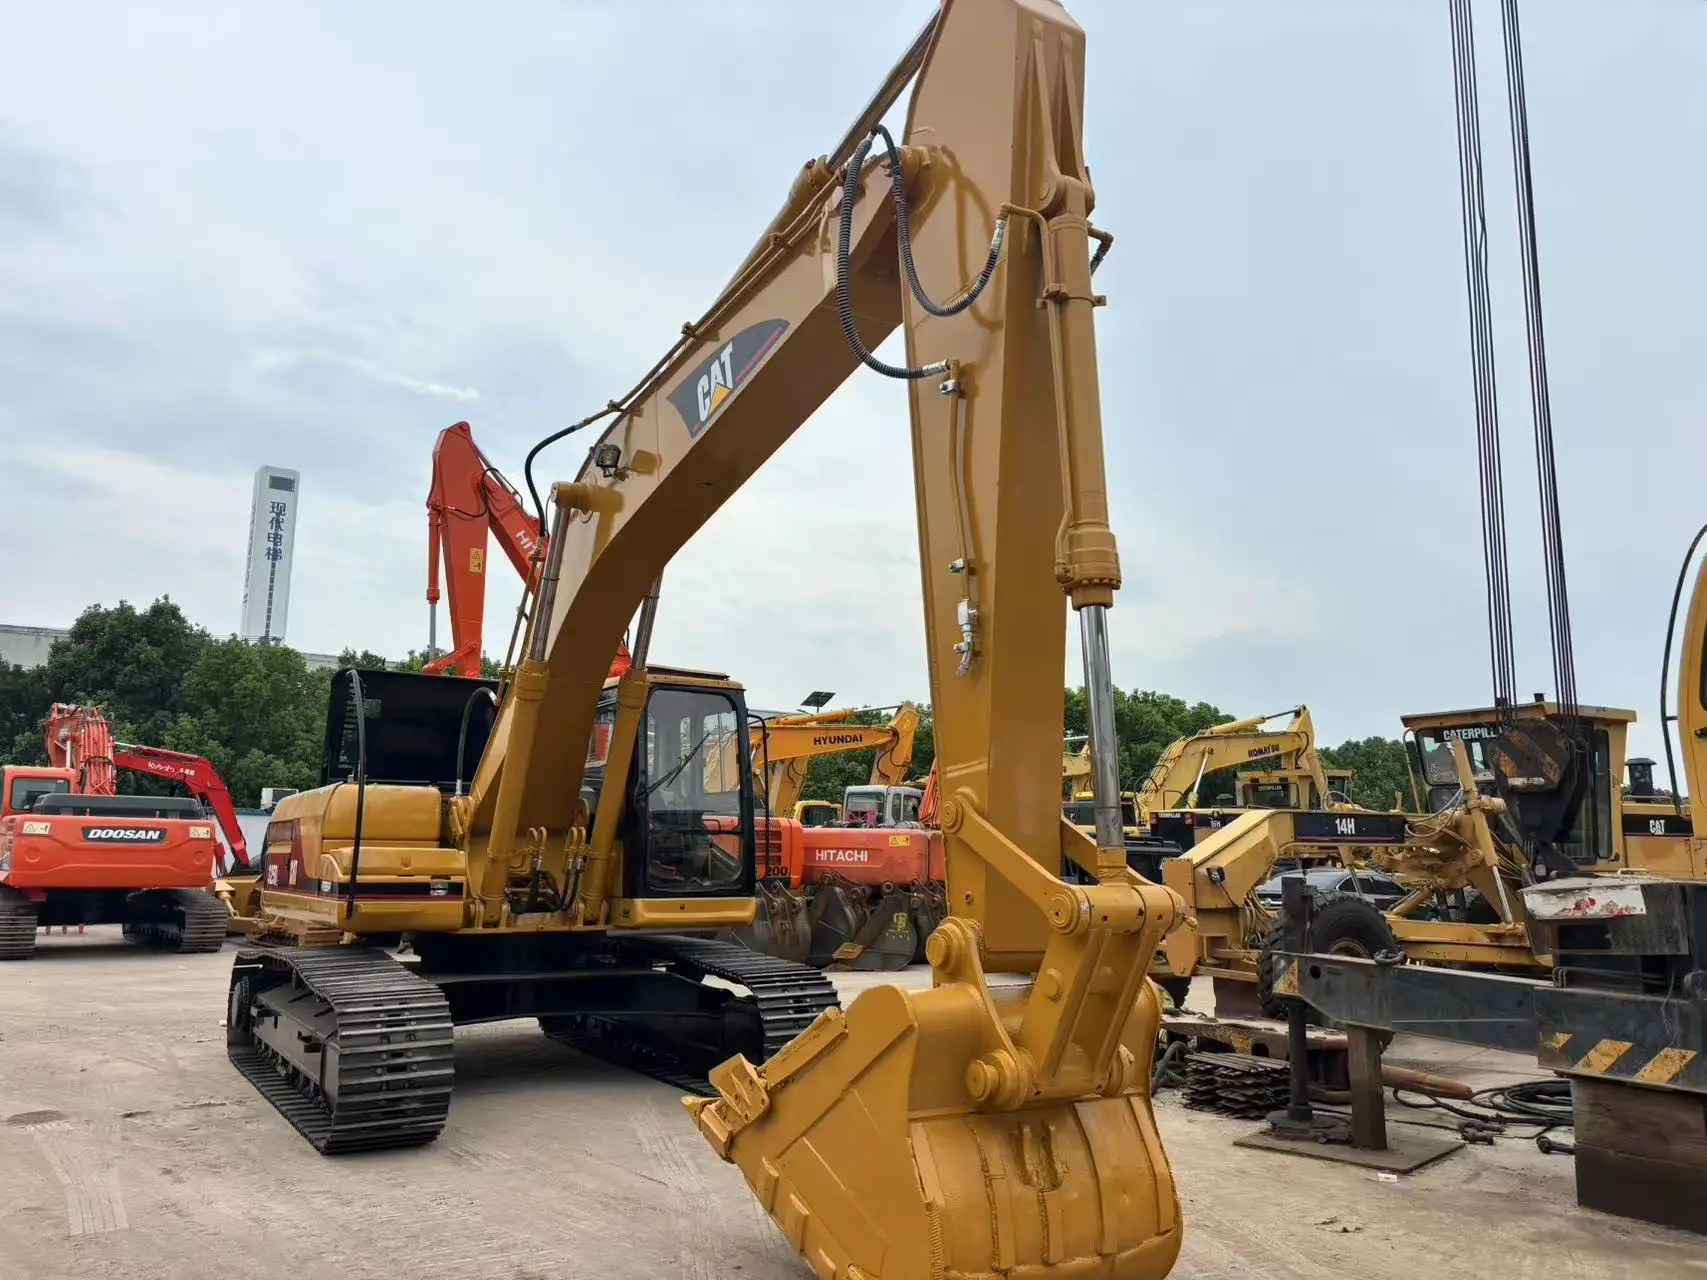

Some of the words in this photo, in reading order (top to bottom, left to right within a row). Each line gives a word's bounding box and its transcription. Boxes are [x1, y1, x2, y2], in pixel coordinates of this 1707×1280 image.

[697, 341, 733, 422] CAT
[264, 500, 287, 561] 现代电梯
[813, 734, 863, 746] HYUNDAI
[1443, 726, 1503, 741] CATERPILL
[1247, 744, 1280, 758] KOMATSU
[1335, 817, 1356, 835] 14H
[1649, 819, 1666, 836] CAT
[88, 828, 161, 840] DOOSAN
[815, 849, 868, 863] HITACHI
[766, 866, 788, 877] 200
